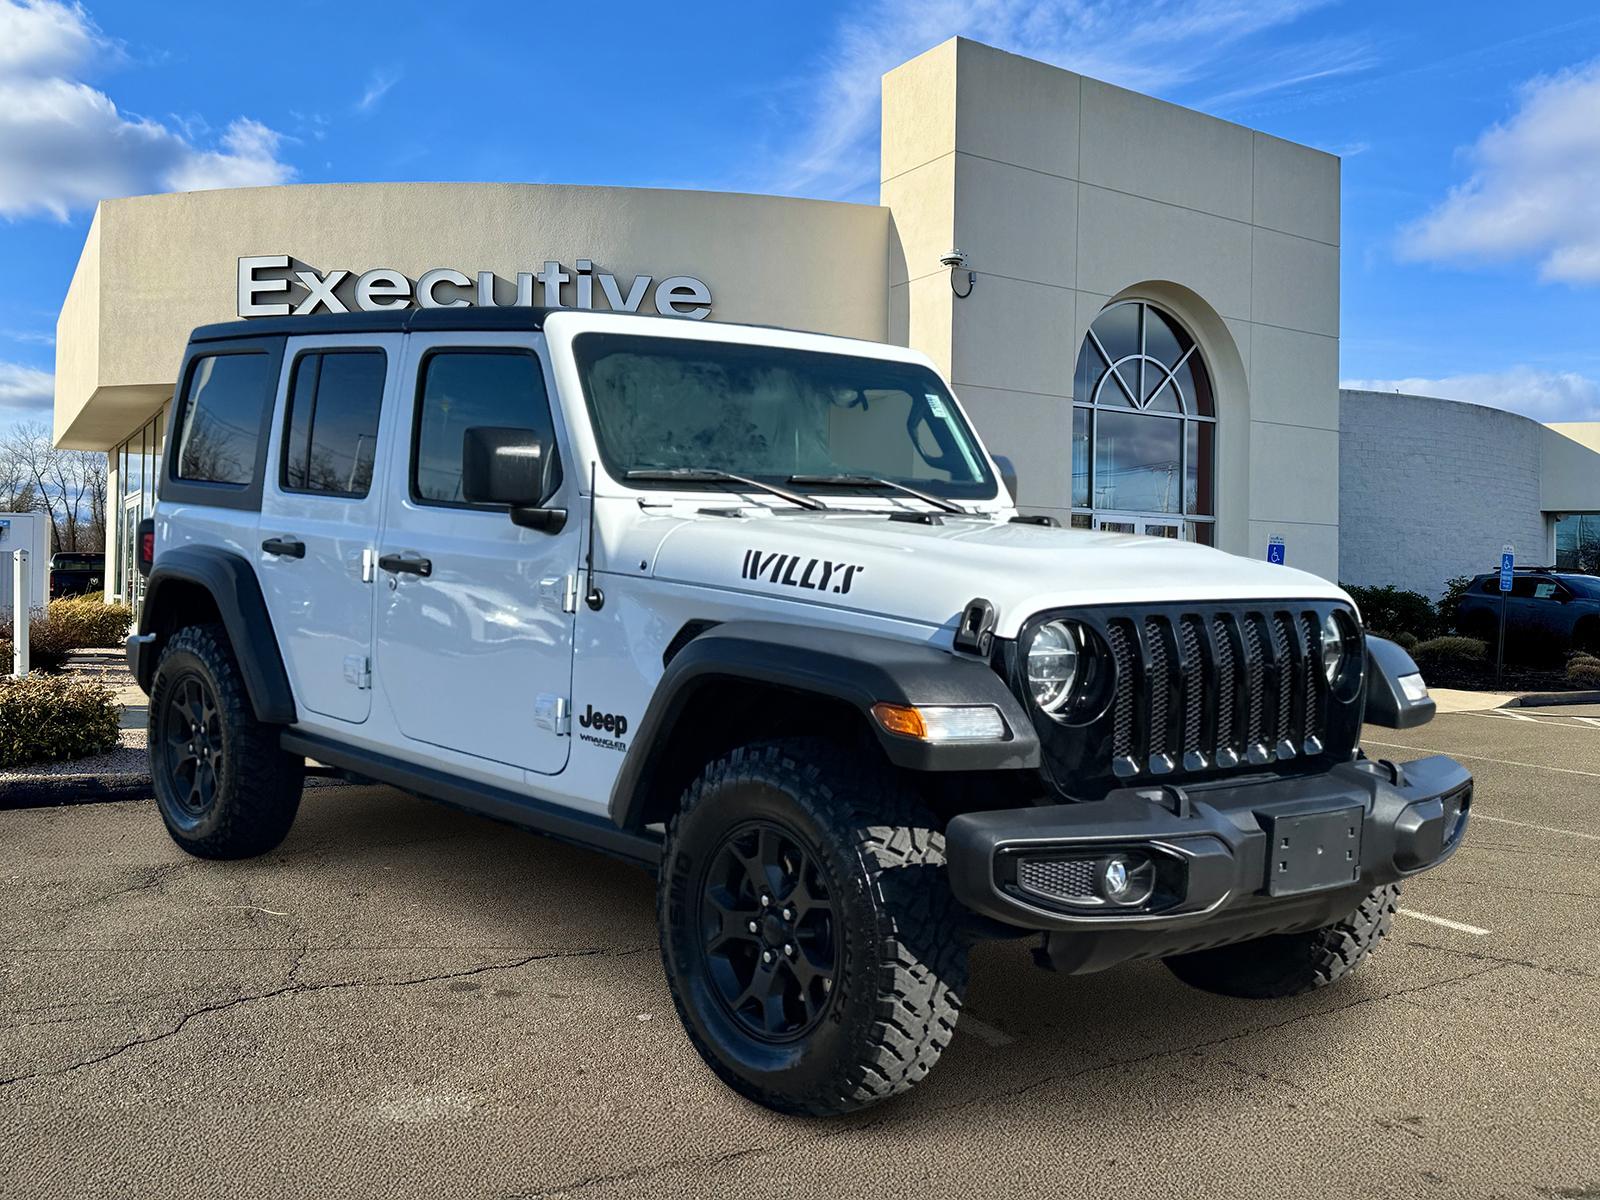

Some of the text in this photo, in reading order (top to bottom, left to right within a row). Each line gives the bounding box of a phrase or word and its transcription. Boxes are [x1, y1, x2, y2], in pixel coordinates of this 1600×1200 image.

[237, 254, 713, 321] Executive
[742, 549, 864, 594] WILLYS
[579, 704, 628, 738] Jeep
[580, 733, 626, 750] WRANGLER
